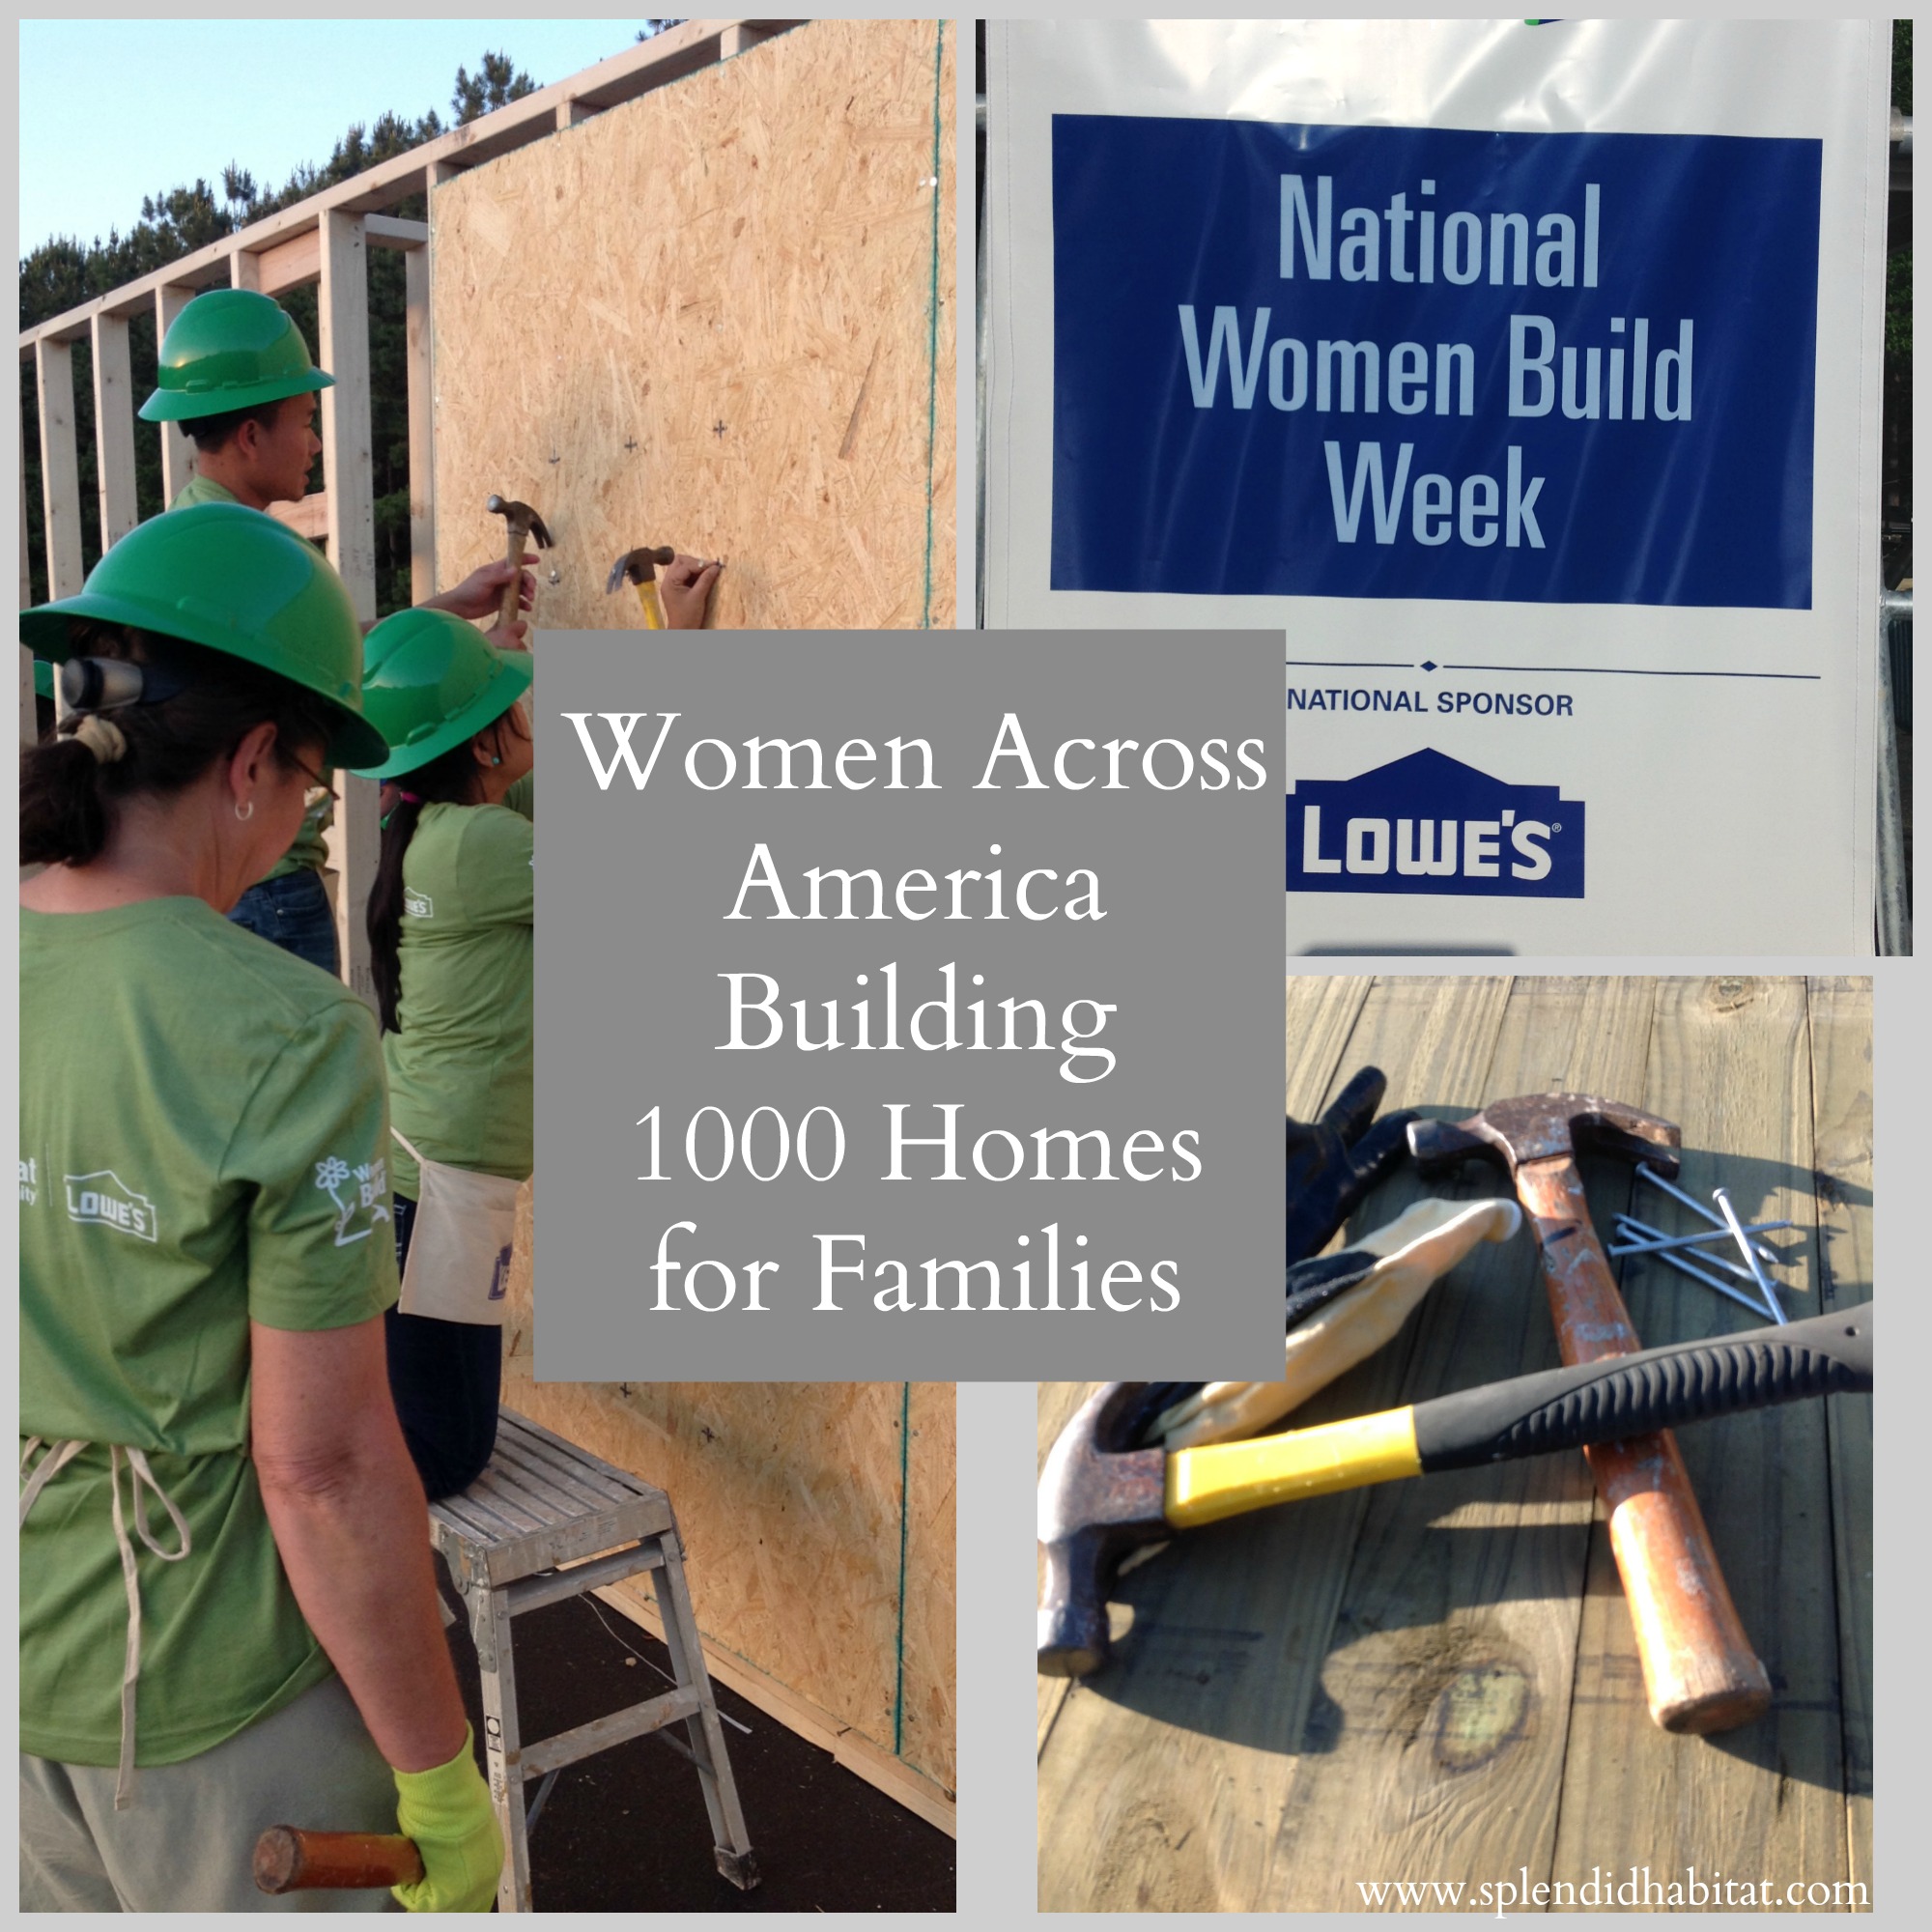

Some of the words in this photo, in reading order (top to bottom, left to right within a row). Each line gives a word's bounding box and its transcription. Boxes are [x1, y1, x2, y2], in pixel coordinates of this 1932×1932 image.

[1279, 174, 1600, 288] National
[1179, 304, 1474, 416] Women
[1508, 315, 1694, 421] Build
[1323, 441, 1547, 549] Week
[1287, 688, 1429, 713] NATIONAL
[1436, 691, 1574, 717] SPONSOR
[66, 1184, 147, 1233] LOWE'S
